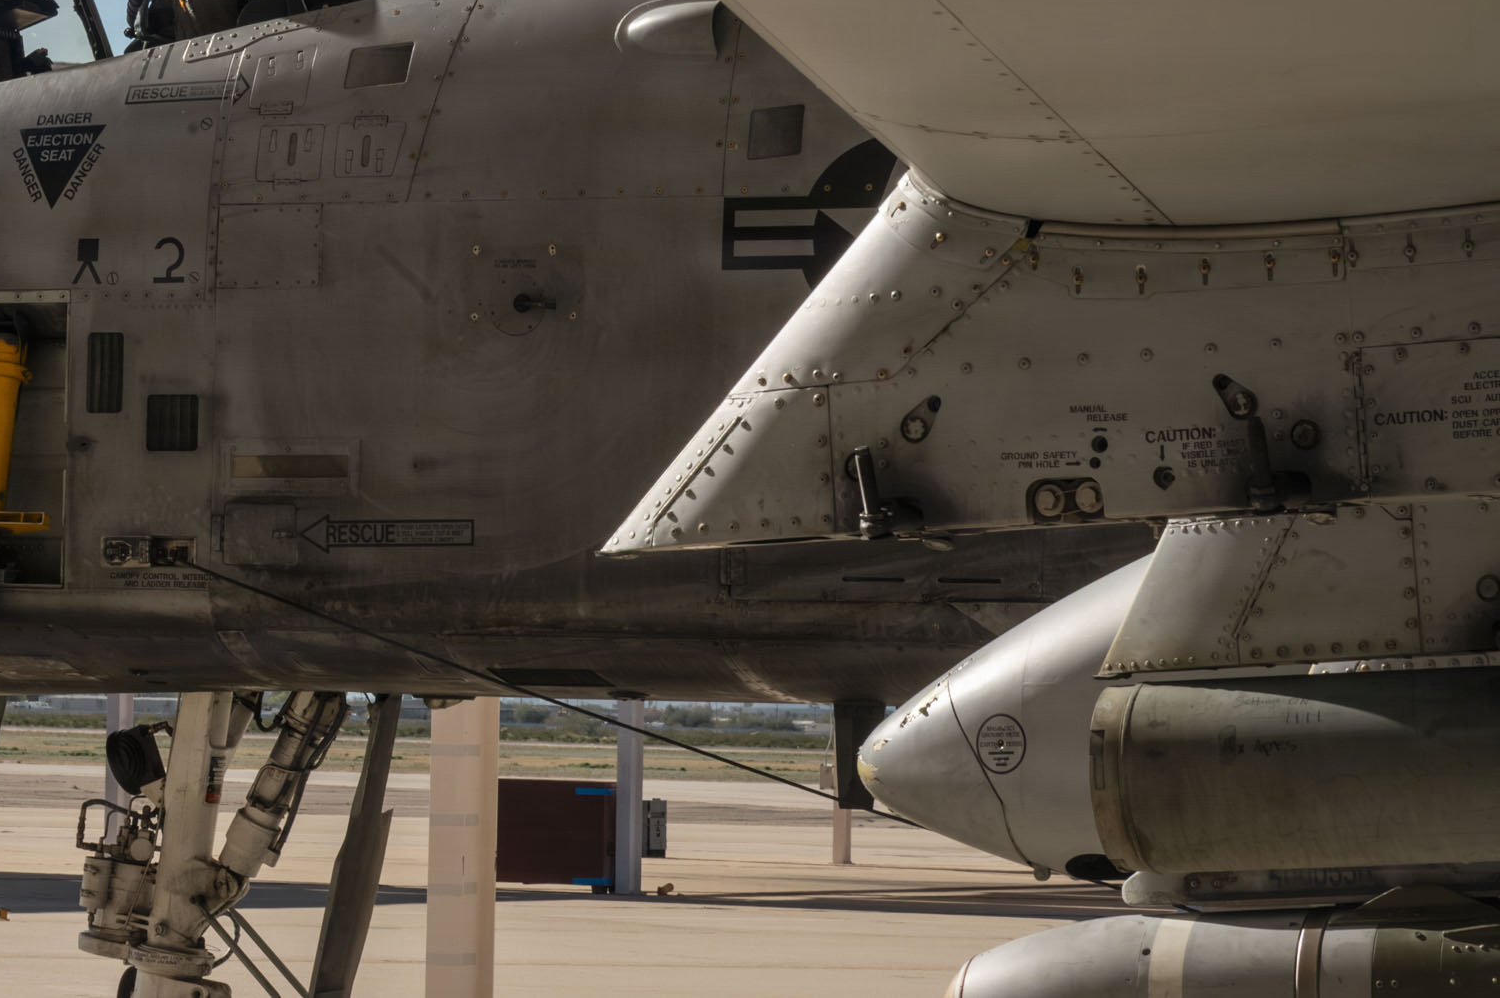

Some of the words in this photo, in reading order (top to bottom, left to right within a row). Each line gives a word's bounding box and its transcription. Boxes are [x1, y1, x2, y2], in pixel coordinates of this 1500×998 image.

[131, 87, 188, 100] RESCUE
[36, 112, 93, 126] DANGER
[27, 133, 94, 147] EJECTION
[40, 149, 75, 162] SEAT
[12, 146, 43, 202] DANGER
[63, 142, 107, 202] DANGER
[1069, 404, 1107, 413] MANUAL
[1452, 409, 1478, 419] OPEN
[1086, 413, 1129, 422] RELEASE
[1374, 409, 1448, 426] CAUTION:
[1452, 419, 1477, 429] DUST
[1145, 427, 1217, 443] CAUTION:
[1453, 428, 1492, 439] BEFORE
[1194, 441, 1213, 450] RED
[1000, 451, 1040, 461] GROUND
[1043, 450, 1078, 460] SAFETY
[1181, 449, 1216, 459] VISIBLE
[1018, 461, 1033, 469] PIN
[1035, 460, 1061, 469] HOLE
[327, 523, 396, 544] RESCUE
[109, 571, 140, 580] CANOPY
[124, 580, 139, 588] AND
[141, 580, 170, 588] LADDER
[173, 580, 207, 589] RELEASE
